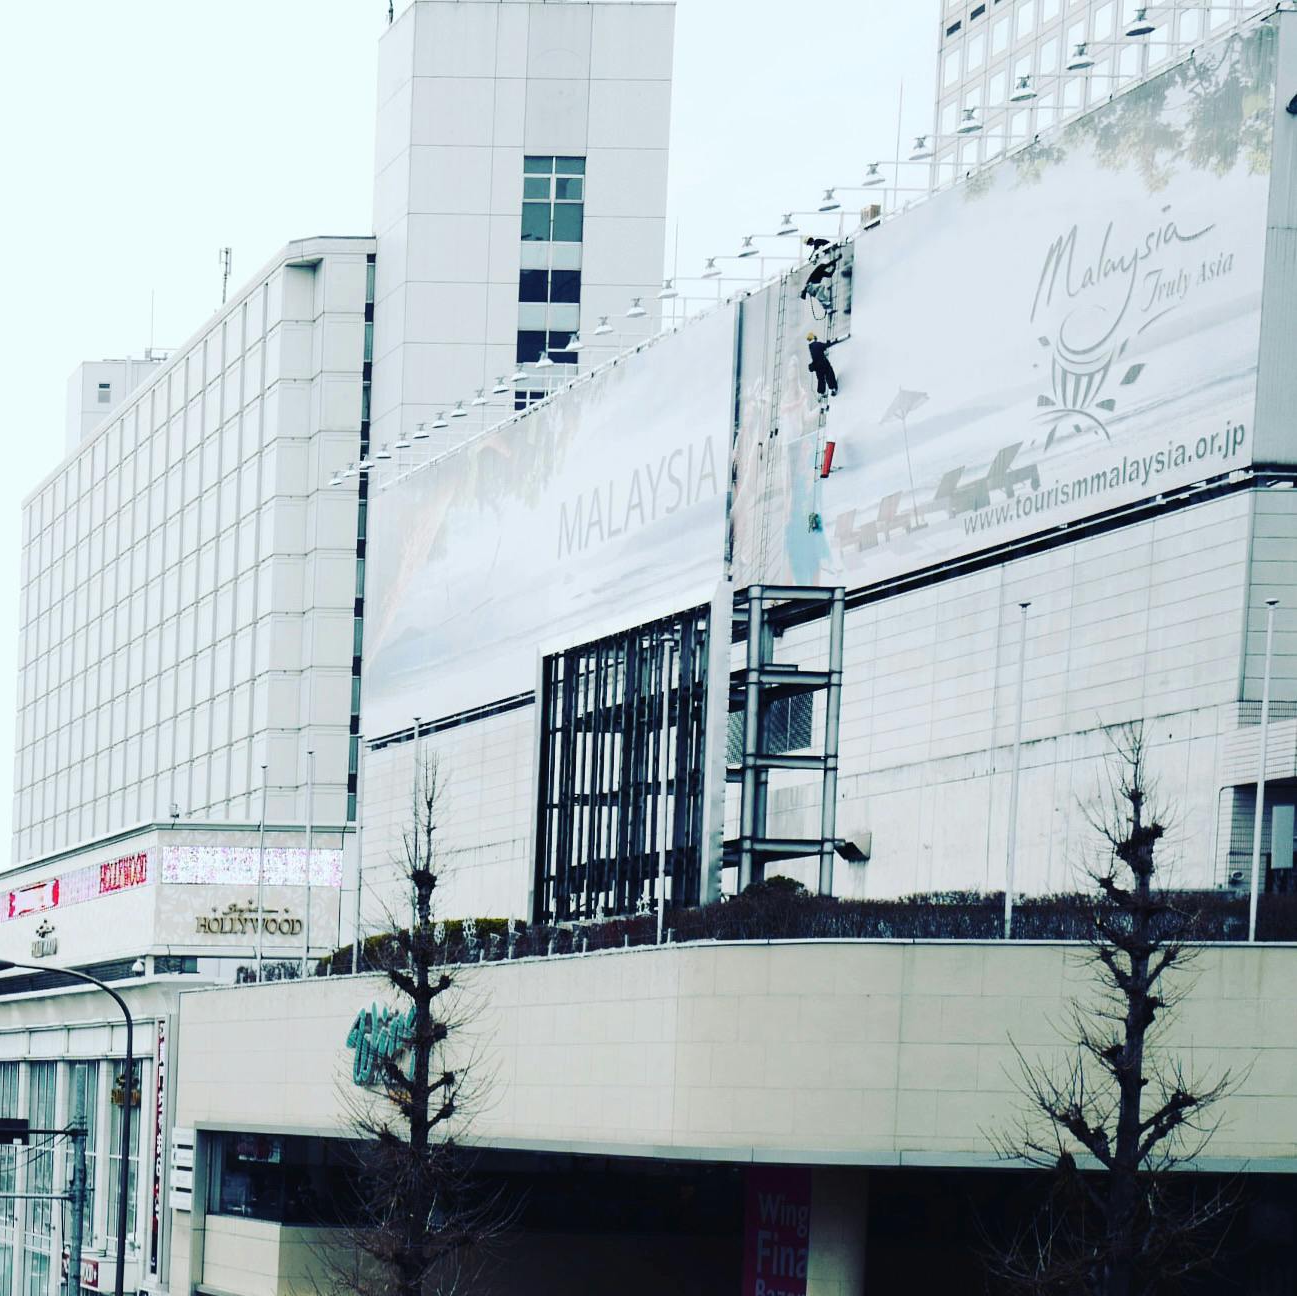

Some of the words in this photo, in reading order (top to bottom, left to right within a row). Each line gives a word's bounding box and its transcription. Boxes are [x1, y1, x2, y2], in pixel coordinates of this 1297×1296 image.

[1031, 204, 1215, 340] Malaysia
[1142, 266, 1191, 314] Truly
[1195, 252, 1235, 286] Asia
[557, 436, 718, 560] MALAYSIA
[963, 420, 1246, 537] www.tourismmalaysia.or.jp
[99, 852, 146, 894] HOLLYWOOD
[195, 916, 302, 936] HOLLYWOOD
[757, 1231, 807, 1279] Fina
